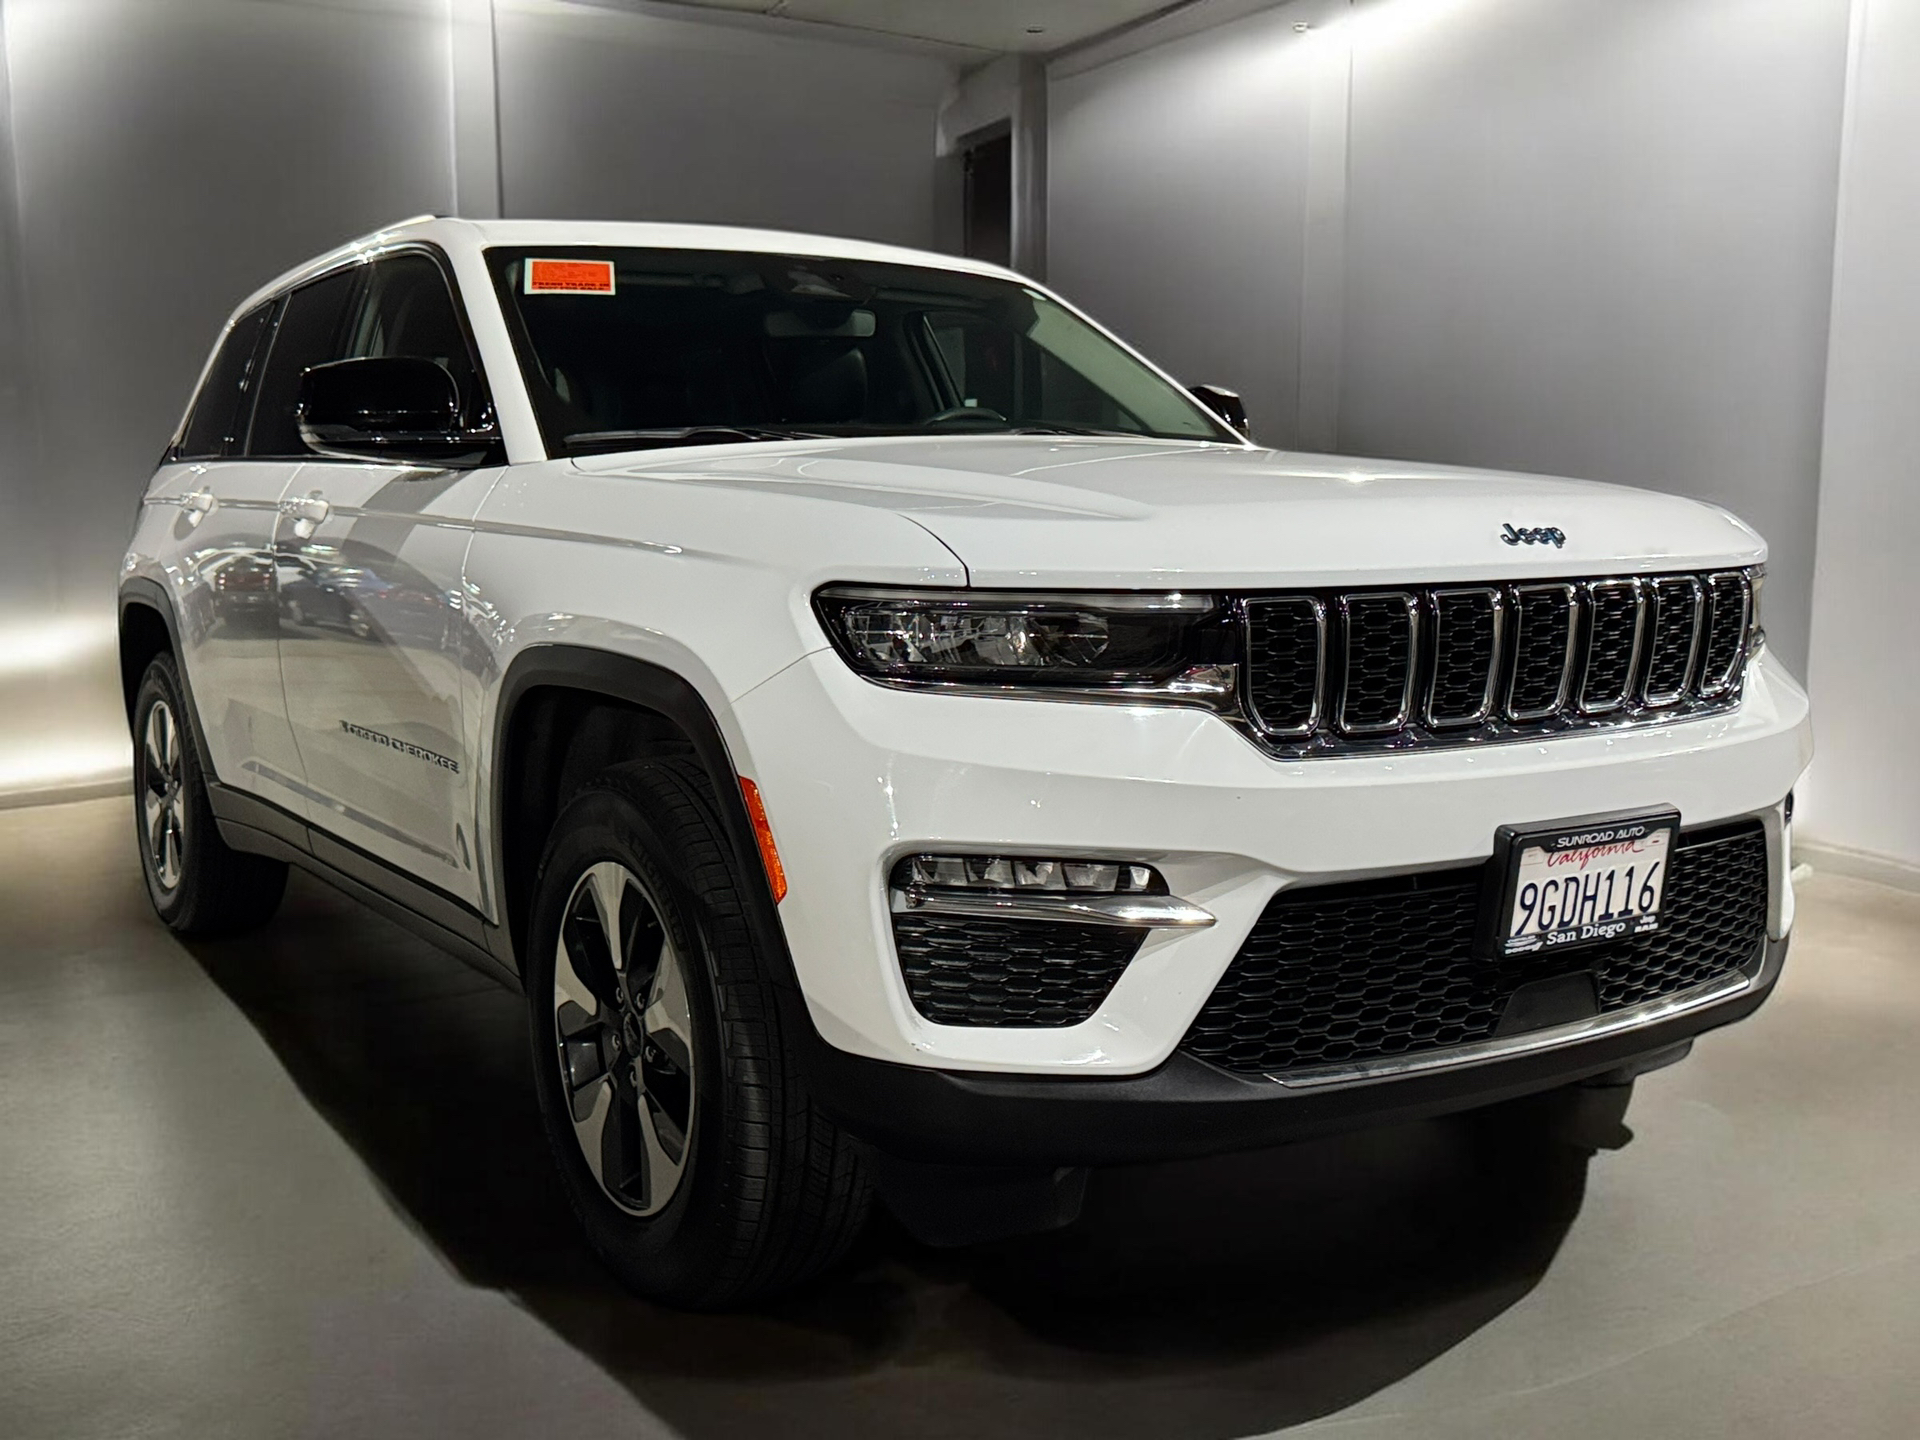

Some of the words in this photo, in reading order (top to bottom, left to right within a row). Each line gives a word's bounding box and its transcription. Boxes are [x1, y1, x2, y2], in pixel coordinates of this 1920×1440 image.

[1500, 523, 1566, 549] Jeep
[1556, 830, 1615, 848] SUNROAD
[1615, 825, 1646, 839] AUTO
[1547, 840, 1645, 870] California
[1514, 860, 1660, 936] 9GDH116
[1546, 930, 1577, 946] San
[1580, 922, 1626, 939] Diego
